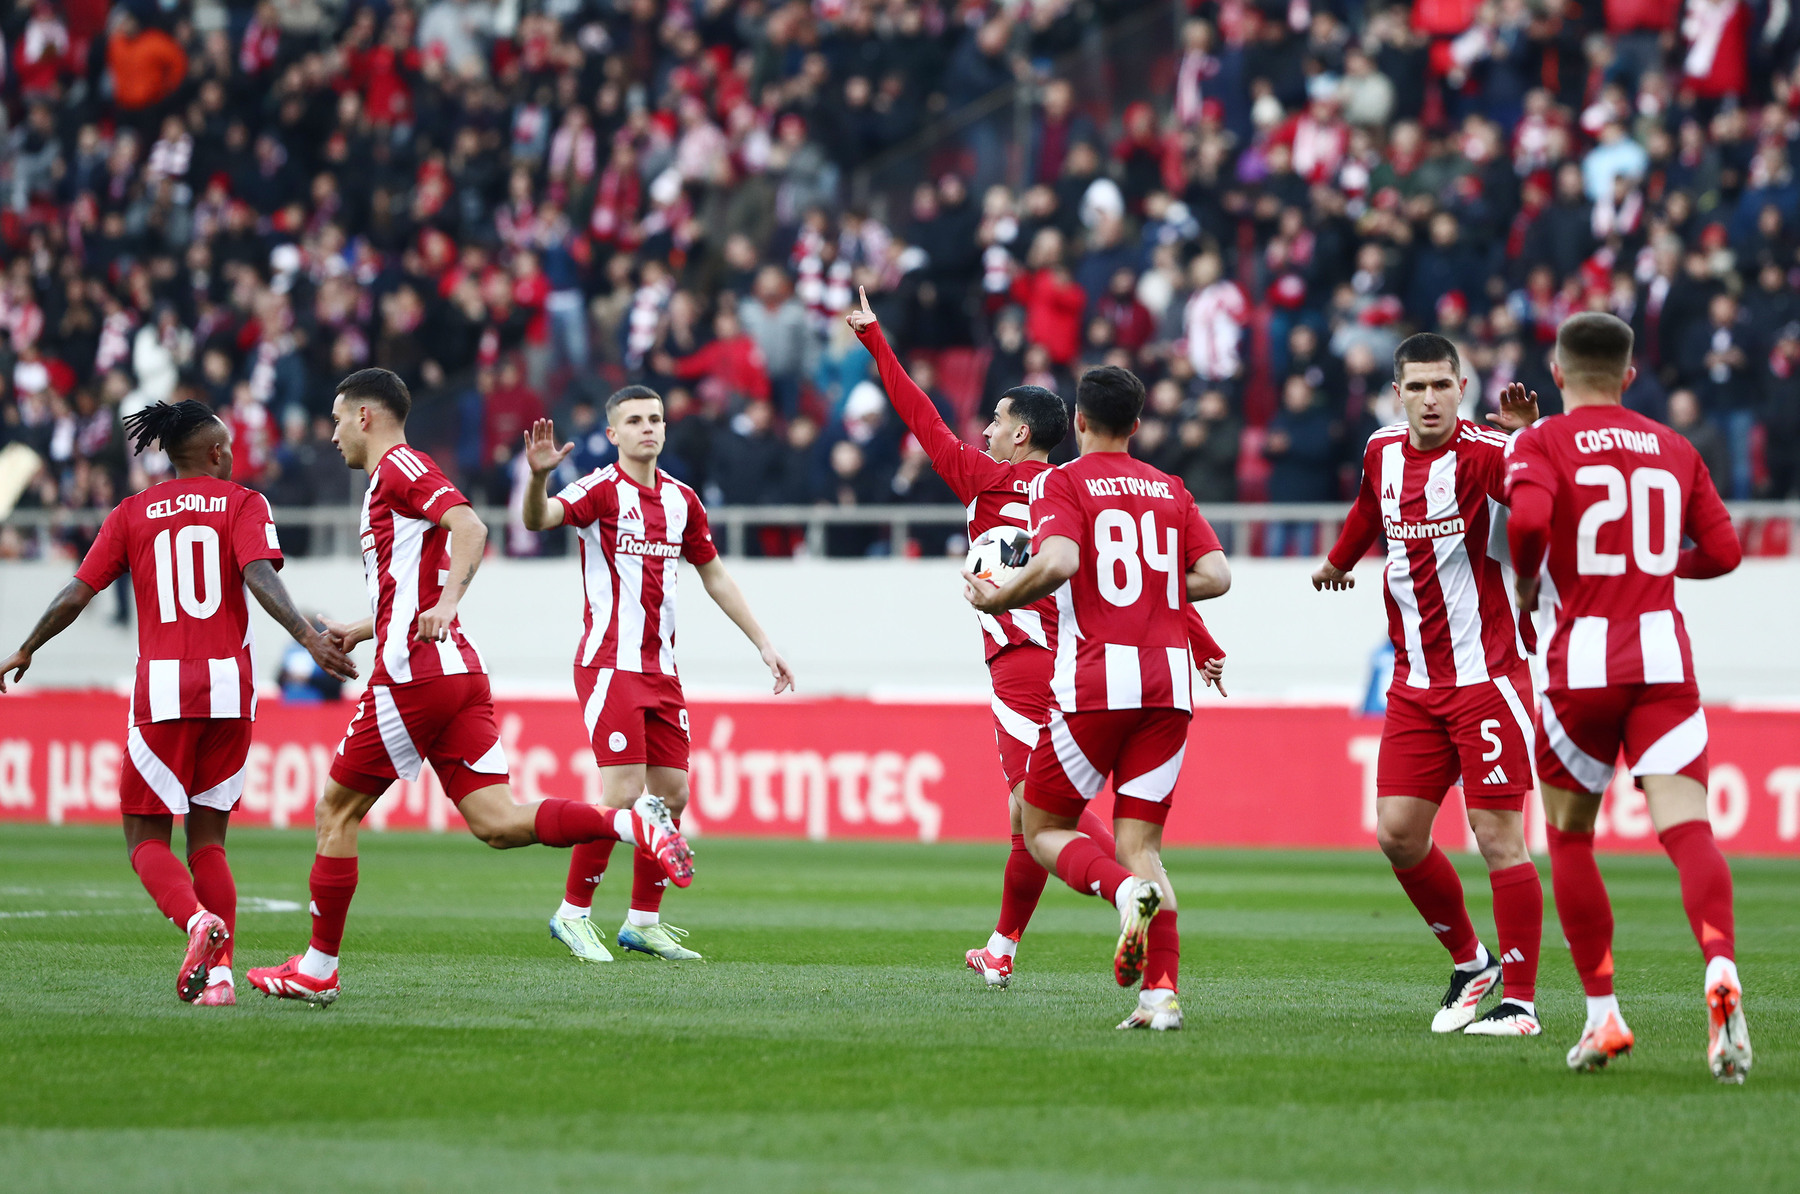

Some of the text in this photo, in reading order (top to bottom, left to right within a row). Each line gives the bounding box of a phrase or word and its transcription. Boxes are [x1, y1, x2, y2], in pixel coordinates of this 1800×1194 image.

[1574, 428, 1661, 455] COSTINHA
[1013, 480, 1031, 494] CH
[1085, 476, 1174, 499] ΚΩΣΤΟΥΛΑΣ
[146, 494, 227, 519] GELSON.M
[1575, 464, 1681, 577] 20
[154, 525, 222, 623] 10
[1094, 508, 1180, 610] 84
[1479, 717, 1502, 762] 5
